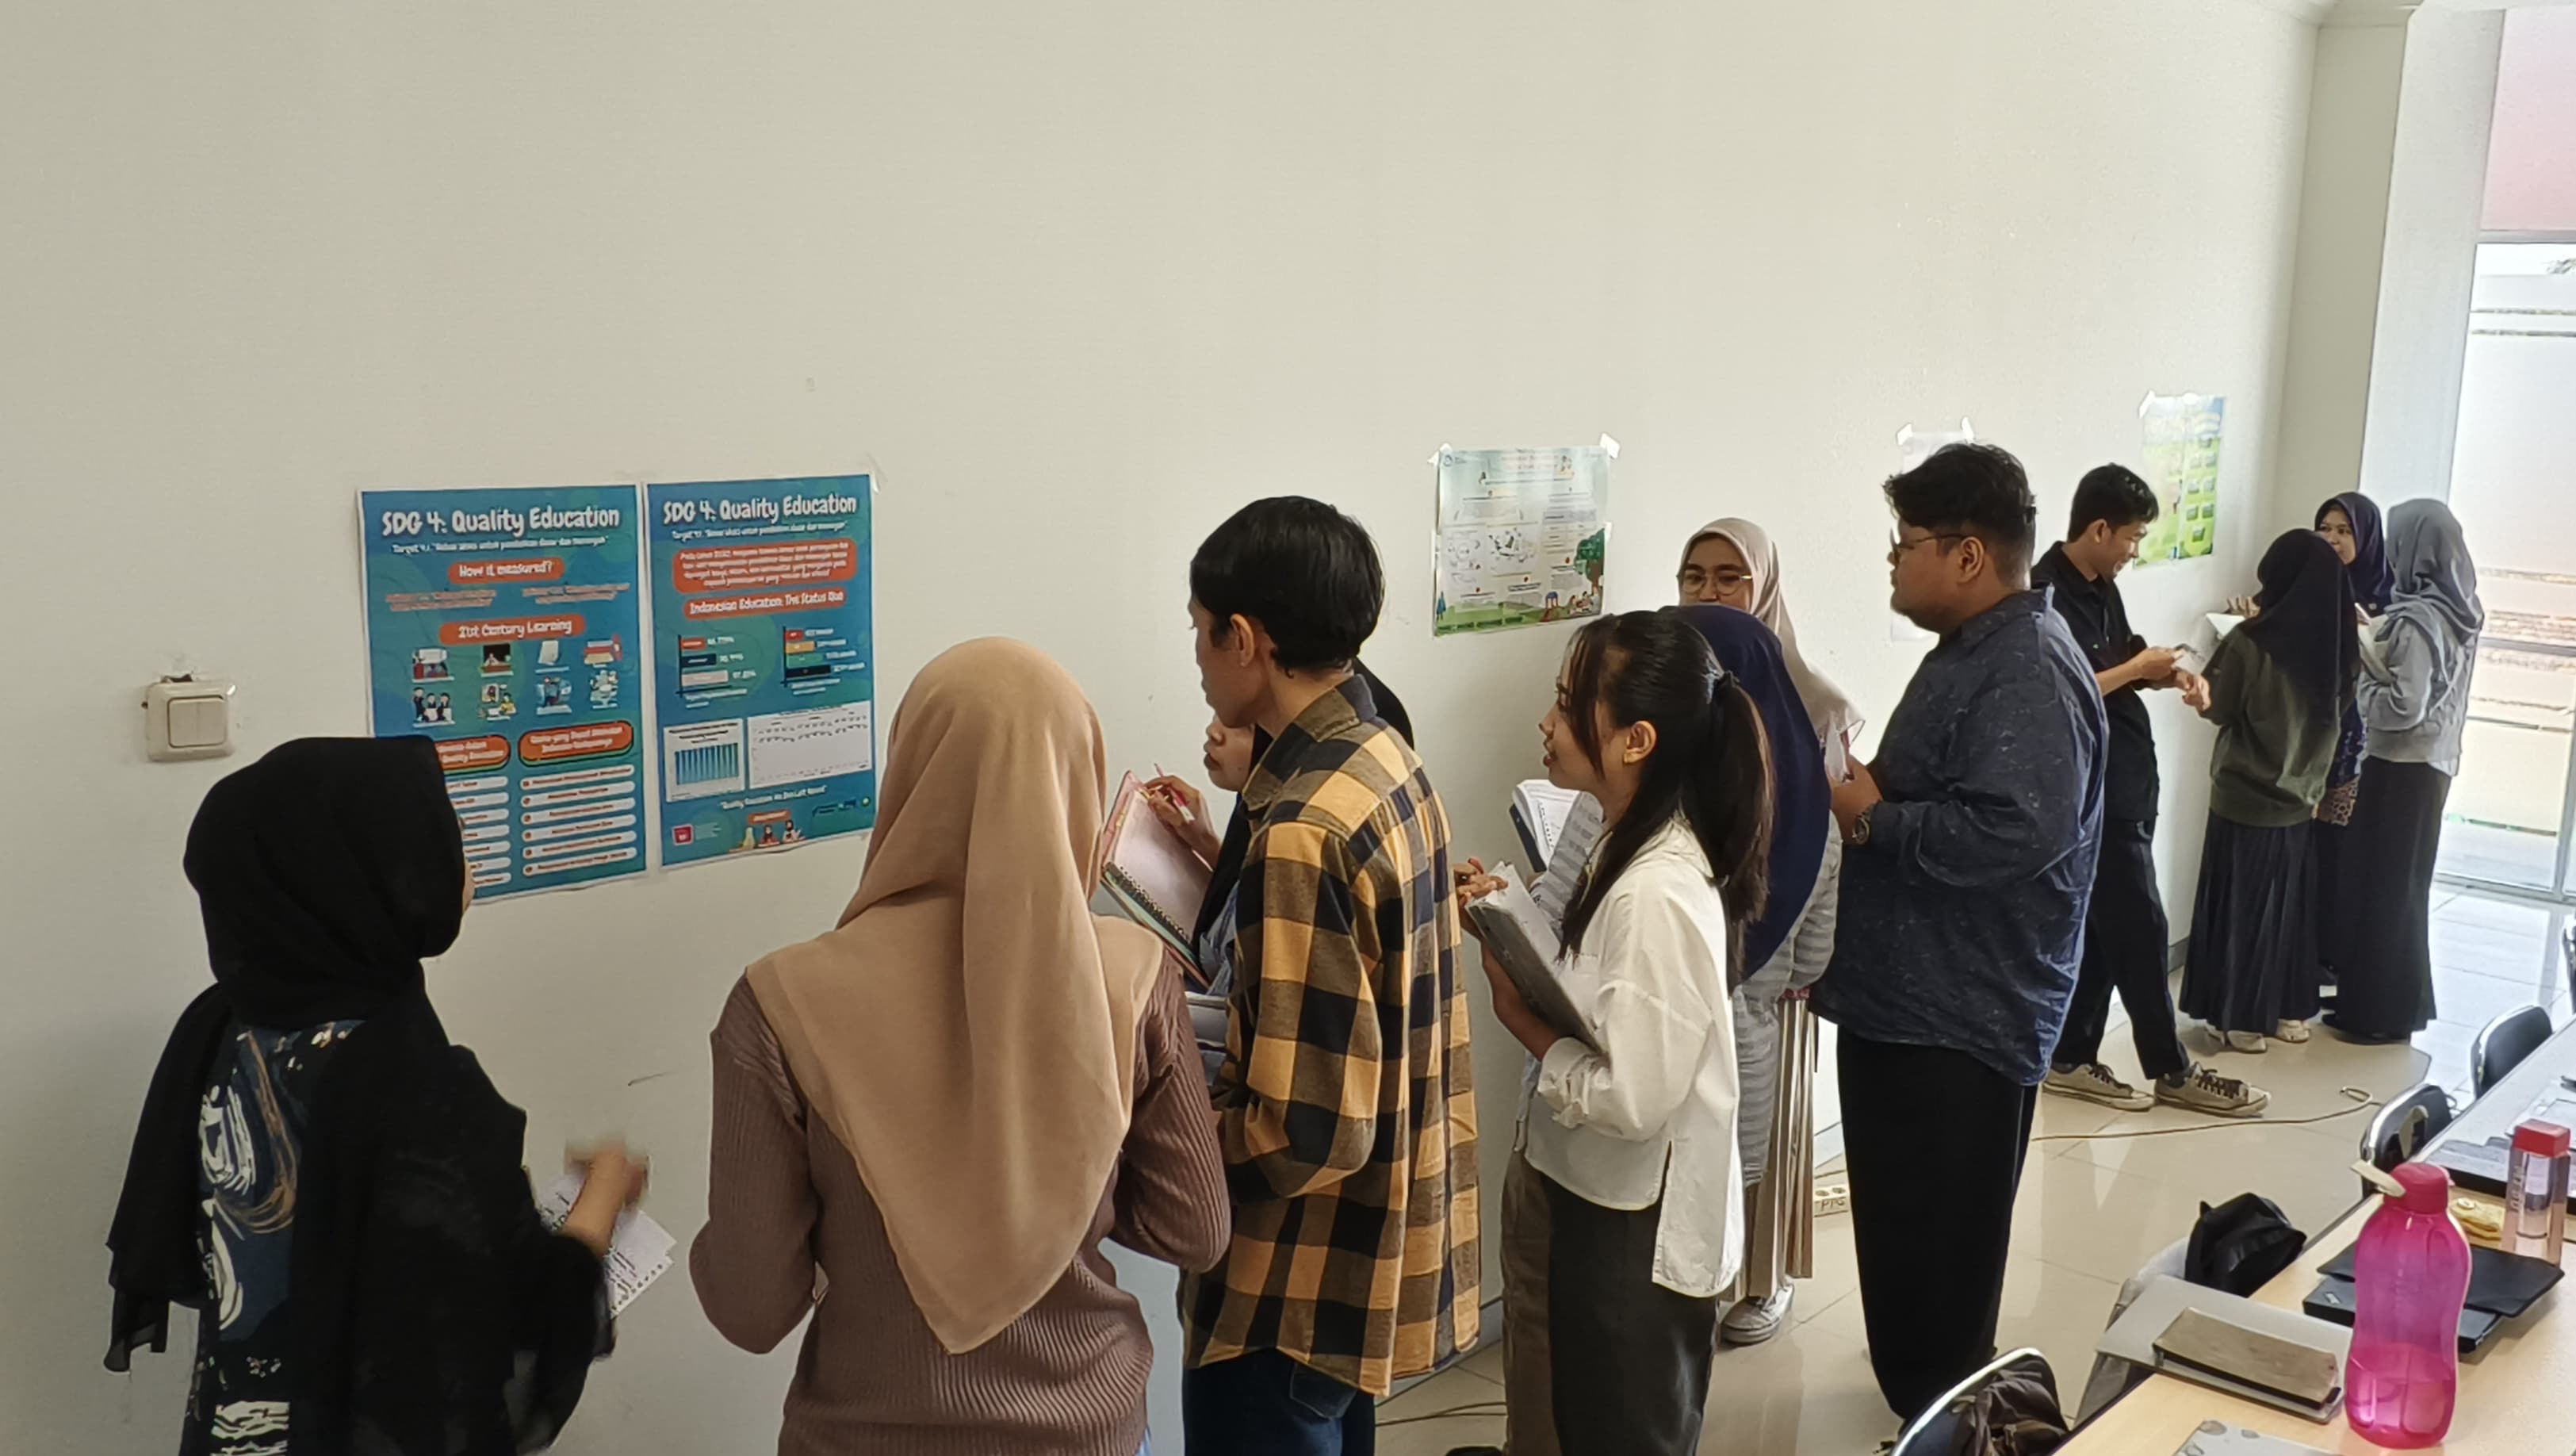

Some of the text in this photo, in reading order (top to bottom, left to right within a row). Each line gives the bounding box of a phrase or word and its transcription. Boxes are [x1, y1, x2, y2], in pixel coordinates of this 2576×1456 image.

[664, 493, 857, 525] SDG 4: Quality Education
[381, 504, 621, 538] SDG 4: Quality Education
[458, 564, 484, 578] How
[496, 560, 553, 576] measured?
[690, 600, 737, 615] Indonesian
[457, 619, 572, 639] 21st Century Learning
